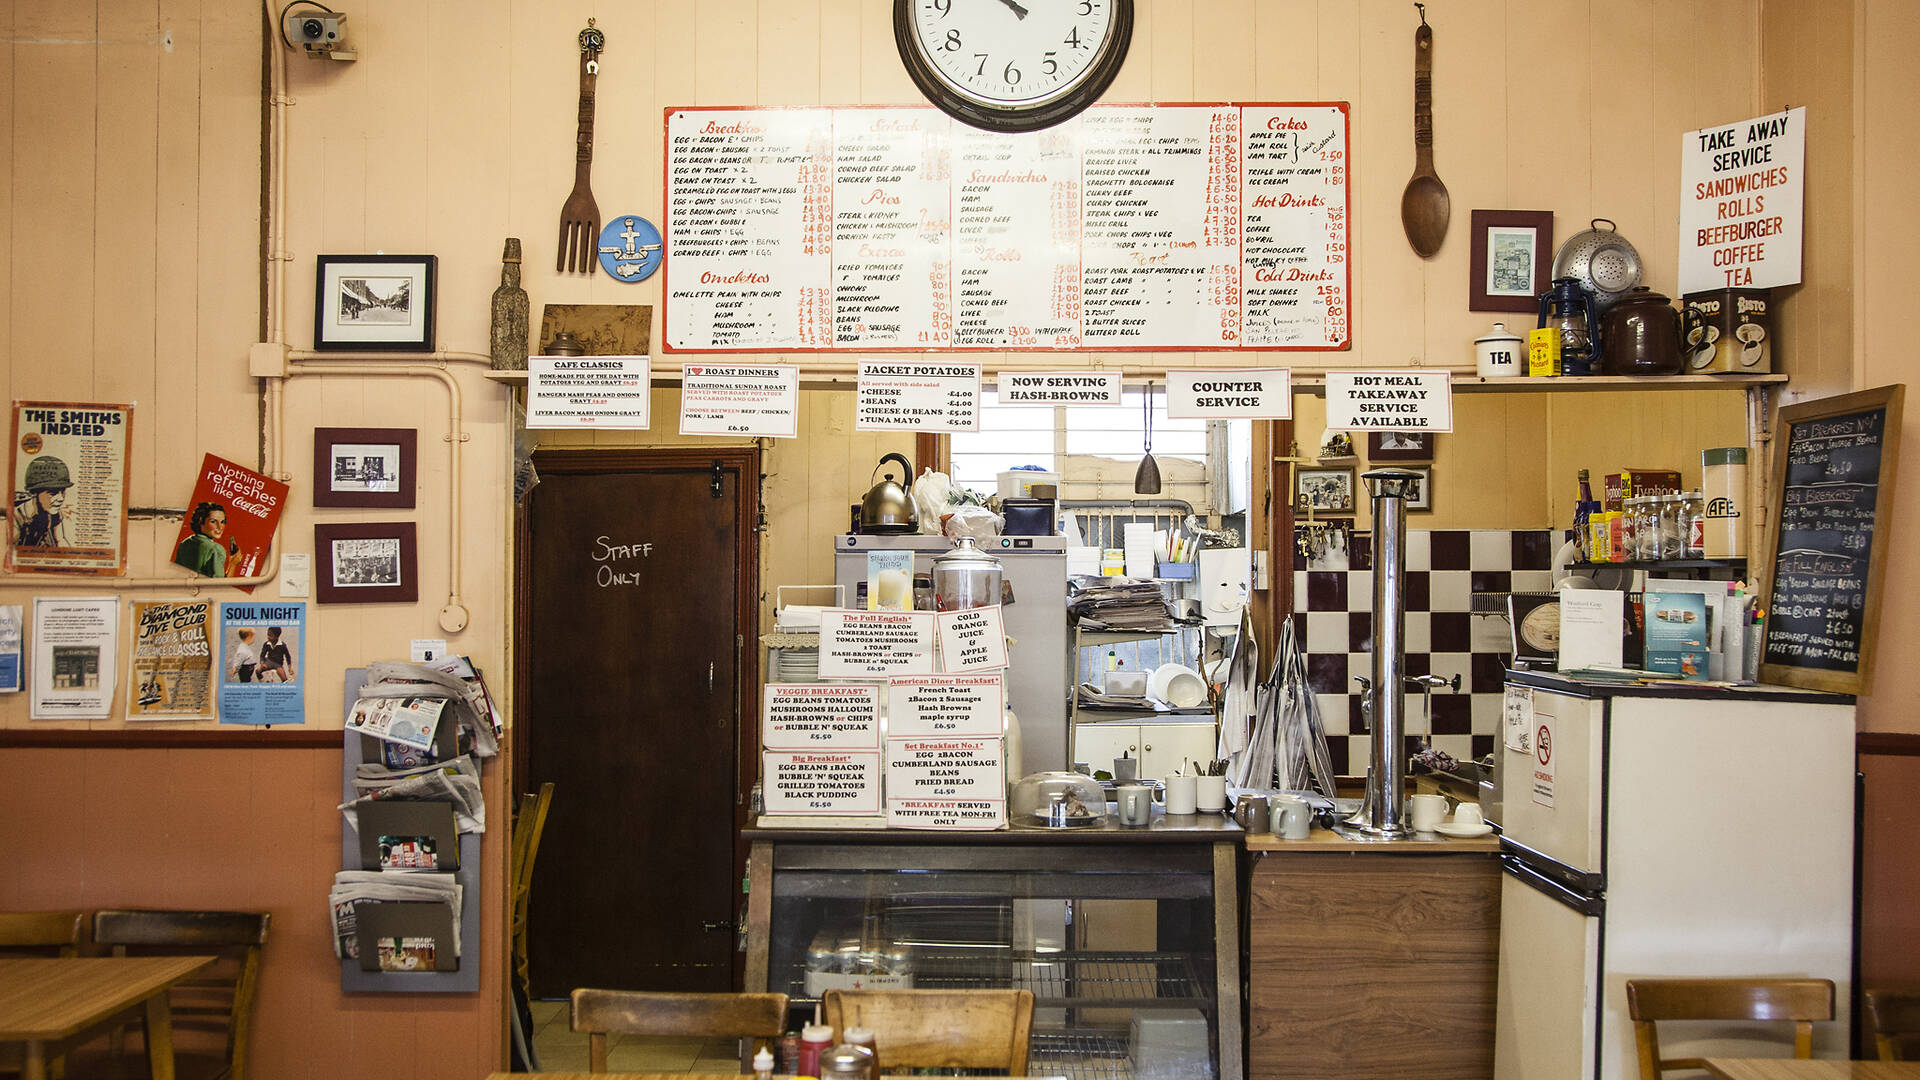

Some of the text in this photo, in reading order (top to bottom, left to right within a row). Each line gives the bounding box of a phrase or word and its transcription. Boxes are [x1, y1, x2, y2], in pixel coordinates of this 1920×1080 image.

[934, 0, 952, 20] 9
[1077, 0, 1093, 16] 3
[944, 29, 962, 52] 8
[1063, 25, 1081, 49] 4
[973, 53, 989, 76] 7
[1042, 51, 1058, 75] 5
[1003, 60, 1022, 85] 6
[1267, 116, 1308, 131] Cakes
[1699, 116, 1789, 152] TAKE AWAY
[1713, 143, 1772, 172] SERVICE
[1695, 166, 1788, 201] SANDWICHES
[1251, 192, 1326, 208] Hot Drinks
[1717, 195, 1764, 221] ROLLS
[1697, 216, 1783, 247] BEEFBURGER
[1713, 242, 1765, 267] COFFEE
[1255, 268, 1334, 282] Cold Drinks
[1724, 267, 1753, 288] TEA
[1737, 296, 1766, 314] BISTO
[1489, 351, 1512, 365] TEA
[554, 361, 624, 369] CAFE CLASSICS
[864, 365, 975, 376] JACKET POTATOES
[738, 369, 780, 377] DINNERS
[1012, 377, 1107, 387] NOW SERVING
[1191, 381, 1264, 392] COUNTER
[1353, 377, 1423, 386] HOT MEAL
[1009, 391, 1109, 401] HASH-BROWNS
[1347, 390, 1428, 399] TAKEAWAY
[1196, 397, 1260, 407] SERVICE
[1359, 403, 1418, 413] SERVICE
[25, 410, 121, 425] THE SMITHS
[1350, 417, 1429, 427] AVAILABLE
[40, 422, 105, 437] INDEED
[218, 463, 265, 491] Nothing
[207, 471, 277, 506] refreshes
[213, 483, 234, 499] like
[1634, 484, 1675, 497] Typhoo
[591, 535, 653, 562] STAFF
[597, 564, 640, 588] ONLY
[140, 604, 207, 626] DIAMOND
[225, 607, 300, 620] SOUL NIGHT
[957, 612, 980, 621] COLD
[139, 613, 206, 639] JIVE CLUB
[952, 620, 988, 631] ORANGE
[180, 627, 206, 642] ROLL
[958, 630, 984, 639] JUICE
[168, 641, 209, 657] CLASSES
[960, 646, 988, 656] APPLE
[962, 656, 988, 665] JUICE
[918, 686, 971, 694] French Toast
[827, 705, 874, 713] HALLOUMI
[918, 704, 972, 712] Hash Browns
[769, 714, 874, 722] HASH-BROWNS CHIPS
[919, 713, 971, 722] maple syrup
[785, 723, 869, 731] BUBBLE SQUEAK
[891, 759, 998, 768] CUMBERLAND SAUSAGE
[929, 769, 960, 777] BEANS
[777, 782, 866, 790] GRILLED TOMATOES
[914, 778, 975, 786] FRIED BREAD
[784, 791, 858, 799] BLACK PUDDING
[957, 802, 991, 810] SERVED
[933, 818, 957, 826] ONLY
